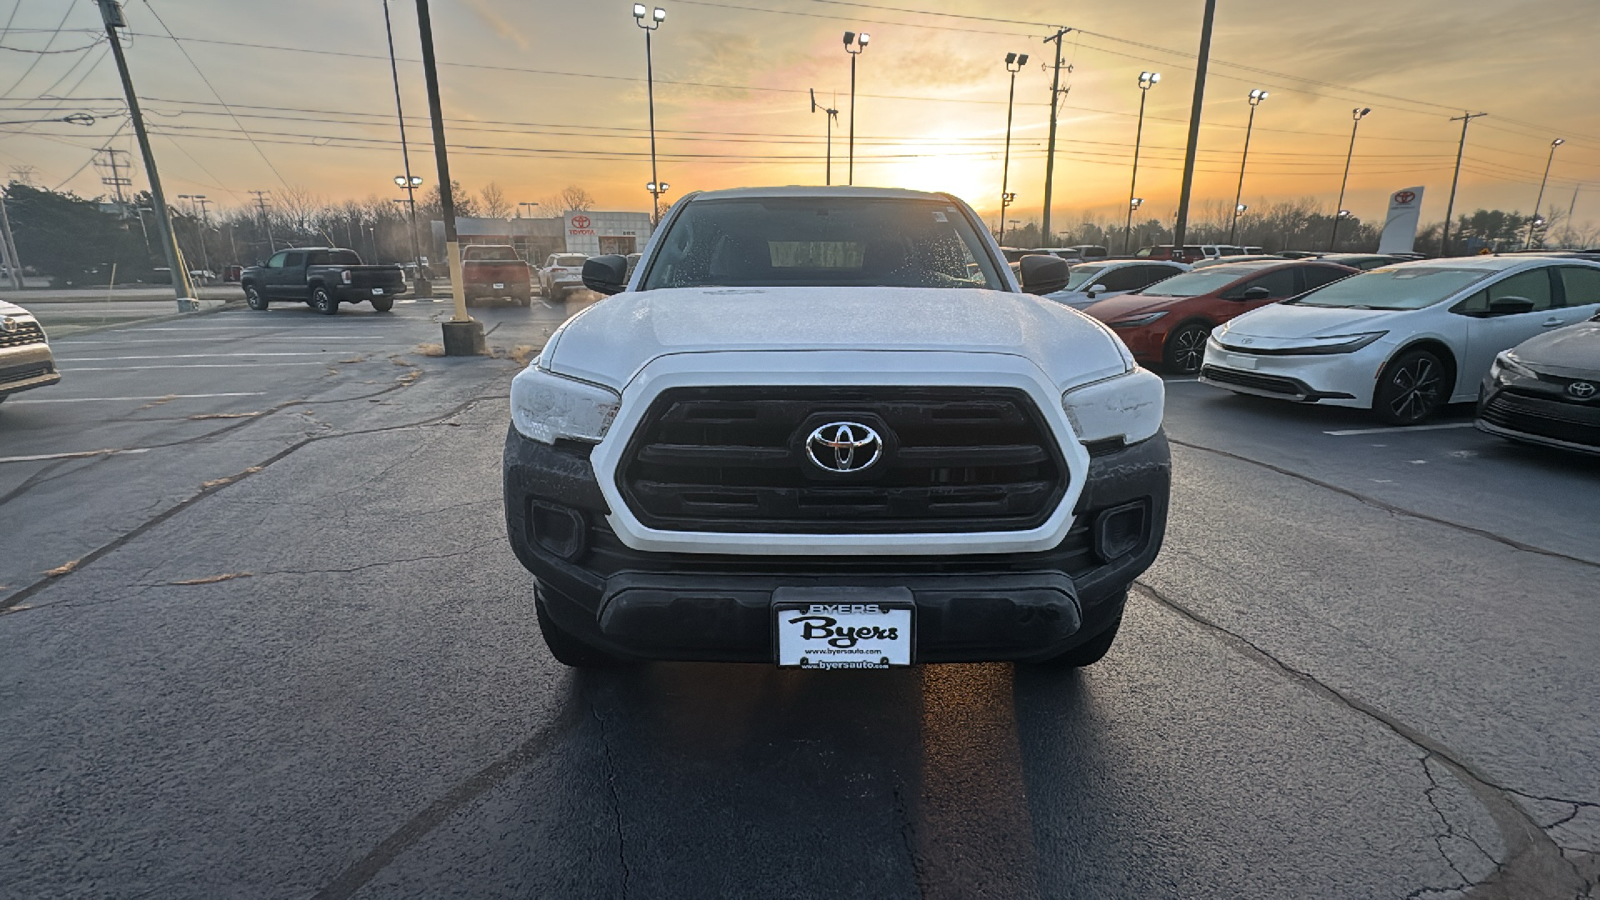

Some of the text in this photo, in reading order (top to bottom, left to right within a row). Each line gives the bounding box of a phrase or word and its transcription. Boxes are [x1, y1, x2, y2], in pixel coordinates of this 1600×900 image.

[809, 604, 880, 614] BYERS
[788, 616, 898, 648] Byers
[801, 660, 889, 670] www.byersauto.com
